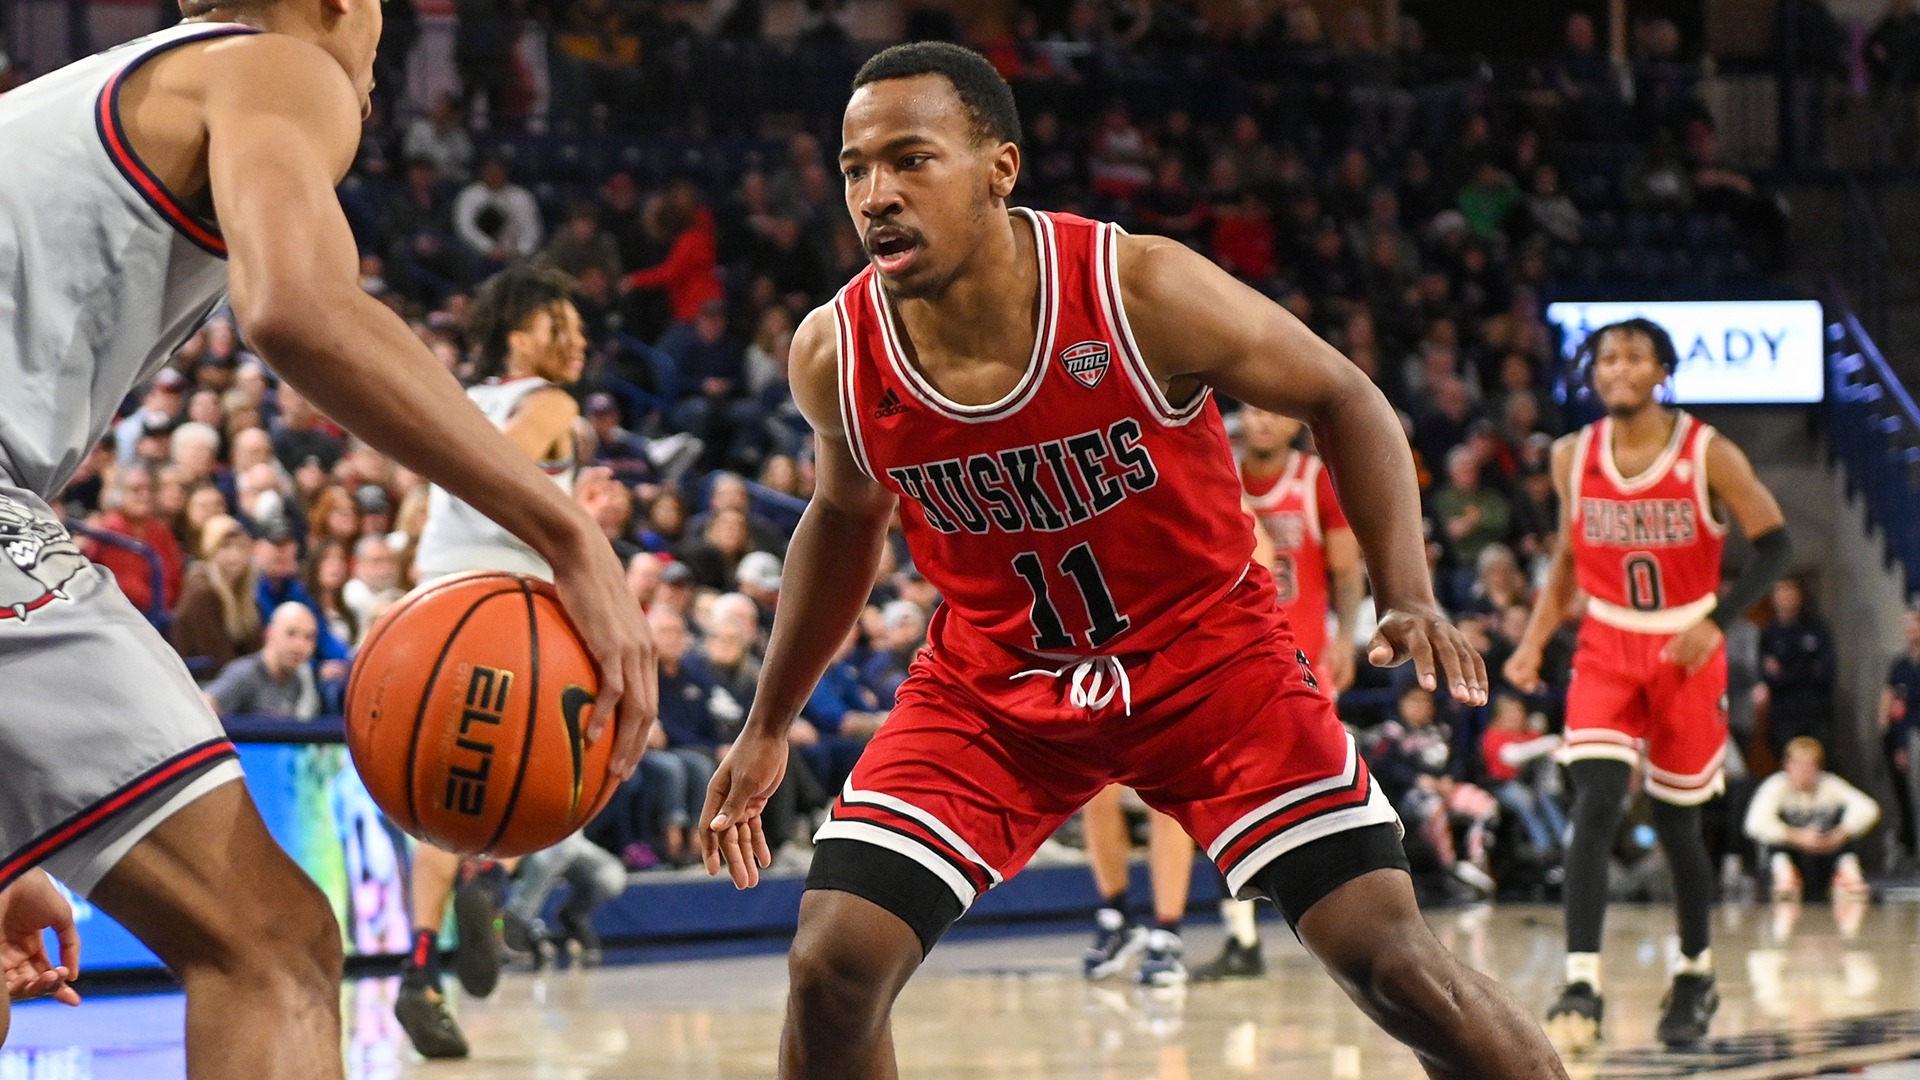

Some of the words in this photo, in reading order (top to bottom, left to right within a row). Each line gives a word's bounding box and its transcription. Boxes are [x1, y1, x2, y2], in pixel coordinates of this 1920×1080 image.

[1067, 354, 1108, 373] MAC
[1687, 329, 1787, 363] ADY
[874, 404, 911, 419] adidas
[886, 417, 1159, 534] HUSKIES
[1579, 497, 1697, 547] HUSKIES
[1011, 541, 1131, 650] 11
[1622, 551, 1665, 612] 0
[444, 665, 514, 816] ELITE
